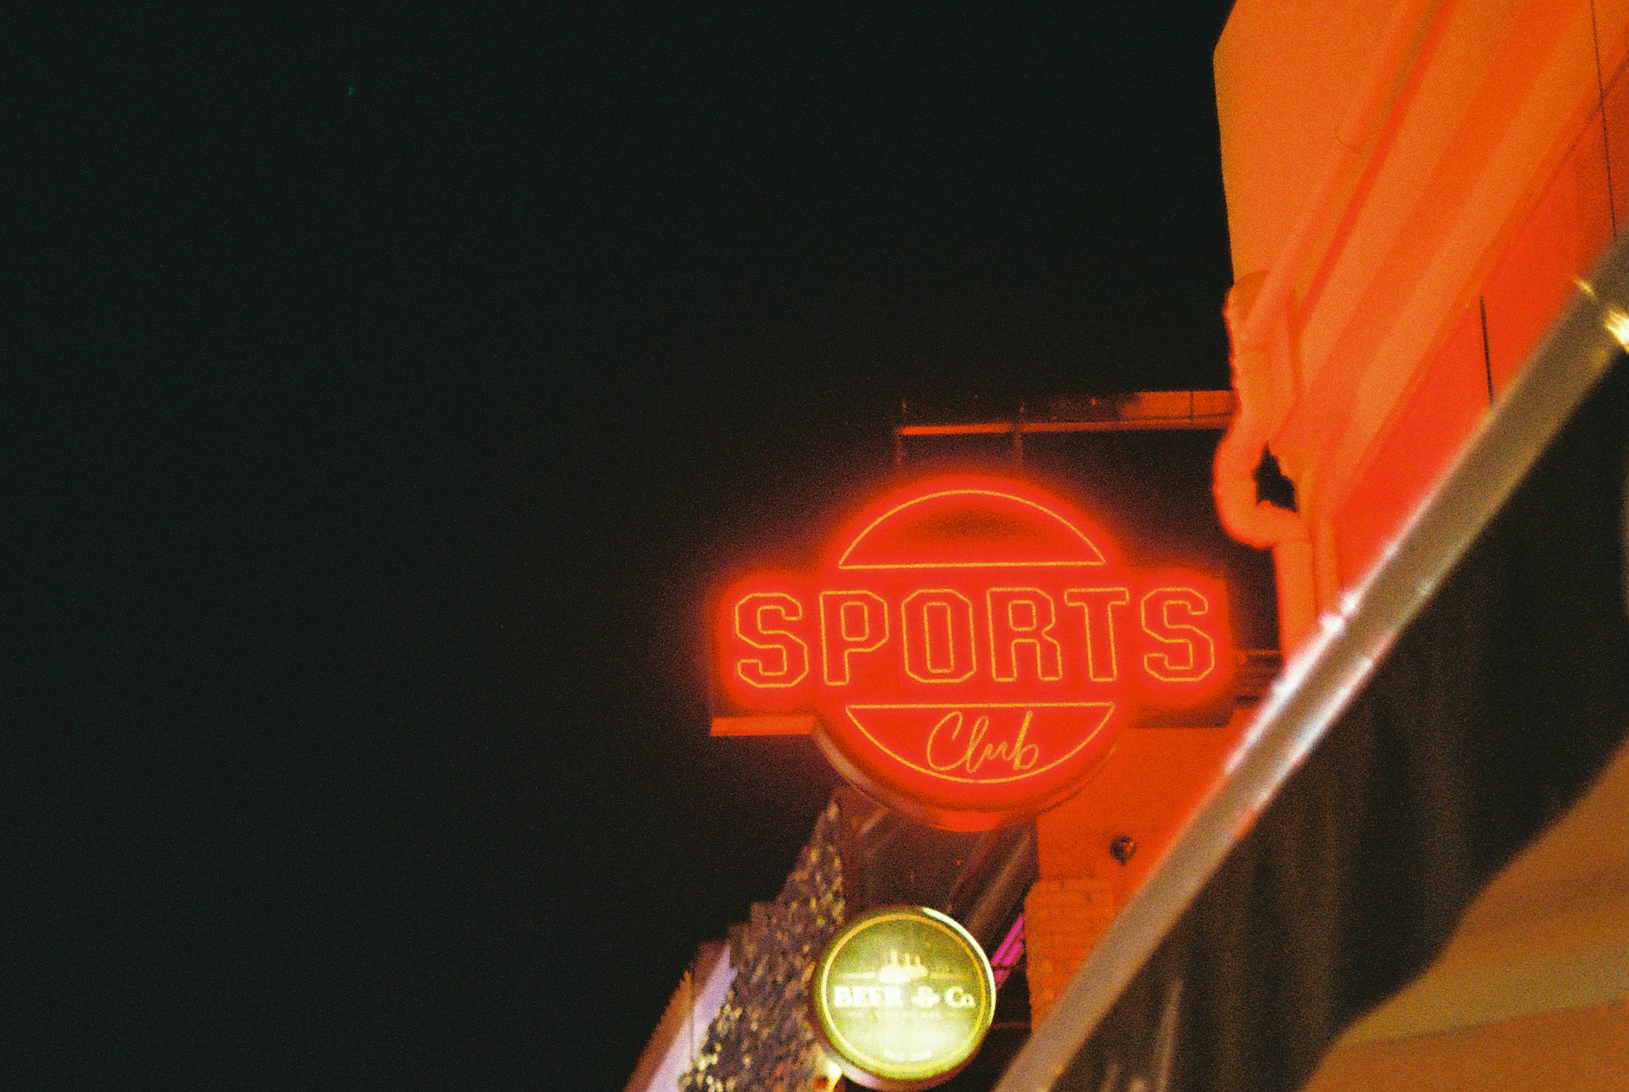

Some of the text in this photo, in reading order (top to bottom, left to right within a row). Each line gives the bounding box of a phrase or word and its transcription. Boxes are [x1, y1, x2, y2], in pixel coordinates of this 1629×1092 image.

[734, 587, 1215, 689] SPORTS
[926, 710, 1040, 773] Club
[833, 985, 903, 1009] BEER
